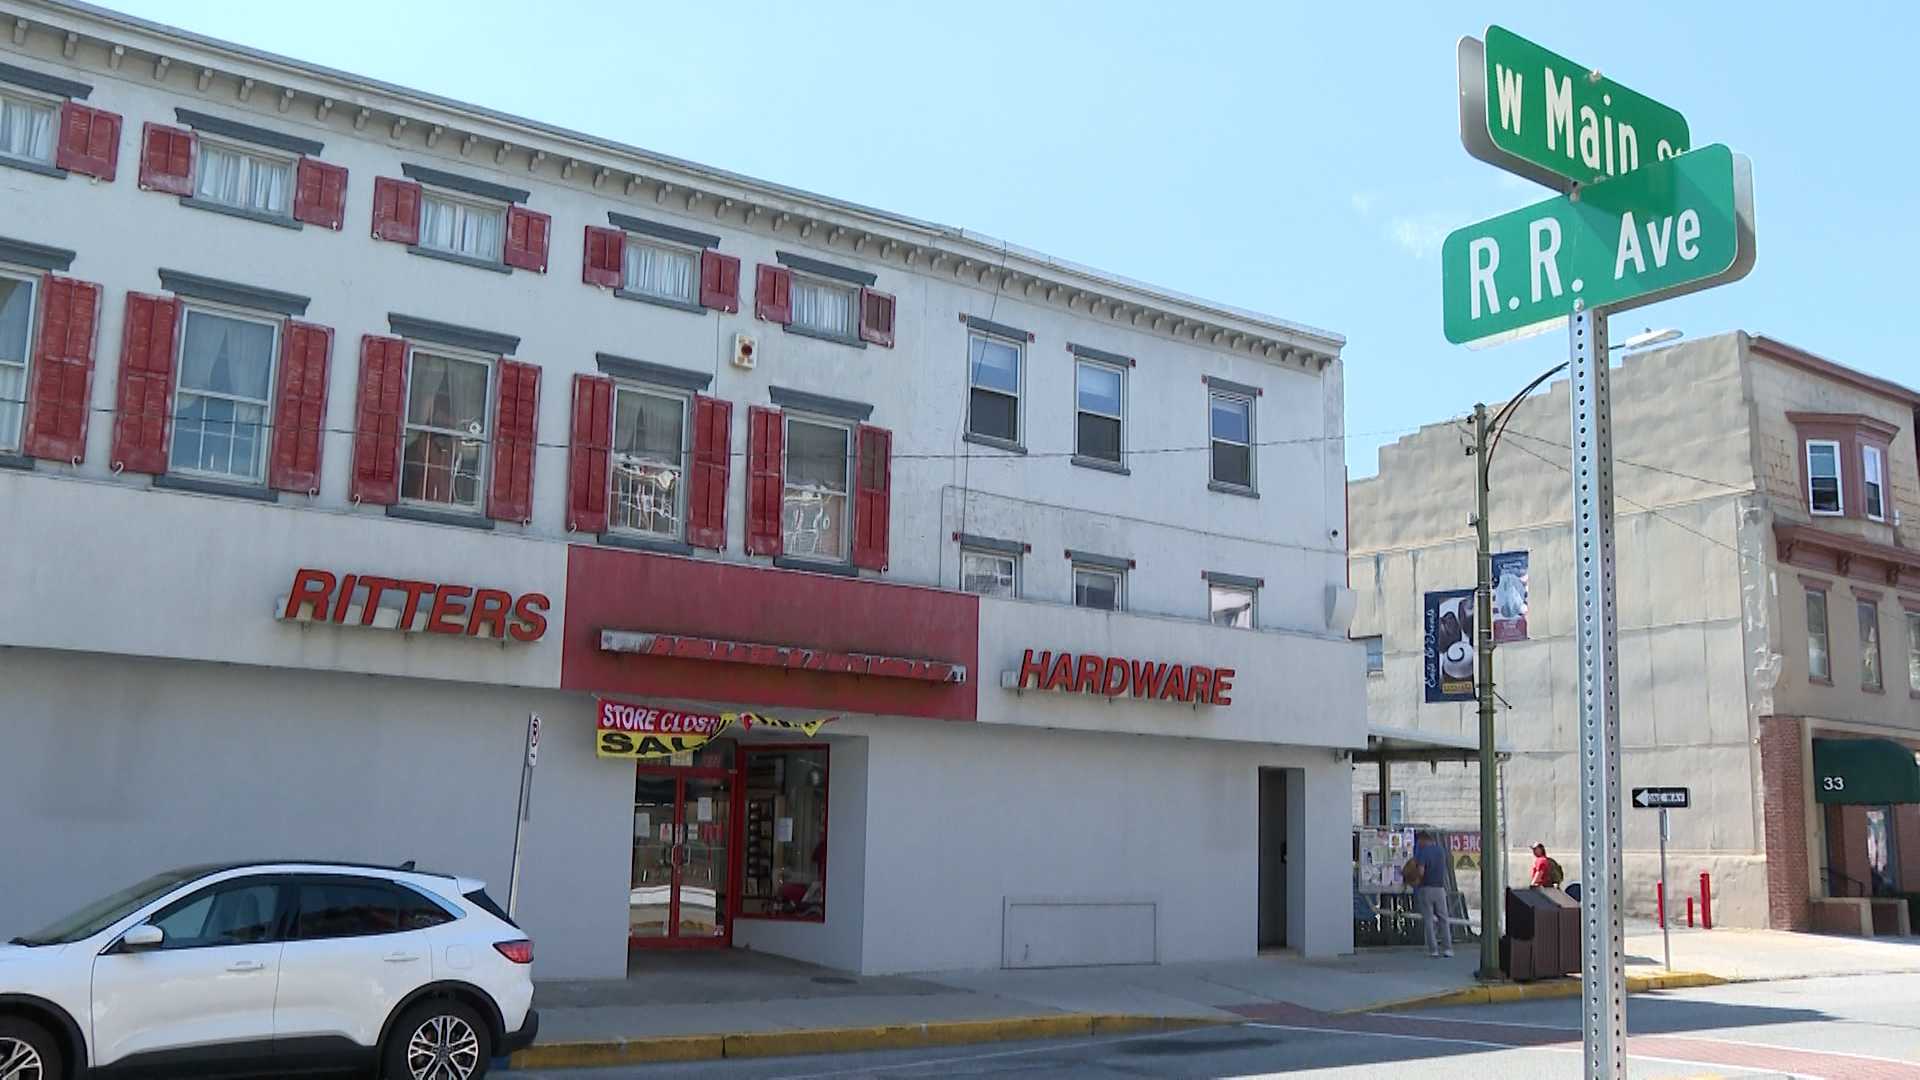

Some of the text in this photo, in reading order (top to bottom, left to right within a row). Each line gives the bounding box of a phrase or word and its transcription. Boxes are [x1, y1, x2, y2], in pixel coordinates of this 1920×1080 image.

[1496, 63, 1639, 177] W Main
[1469, 208, 1701, 320] R.R. Ave
[285, 568, 551, 641] RITTERS
[1018, 649, 1236, 706] HARDWARE
[600, 733, 704, 755] SAL
[602, 703, 659, 731] STORE
[1823, 776, 1845, 790] 33
